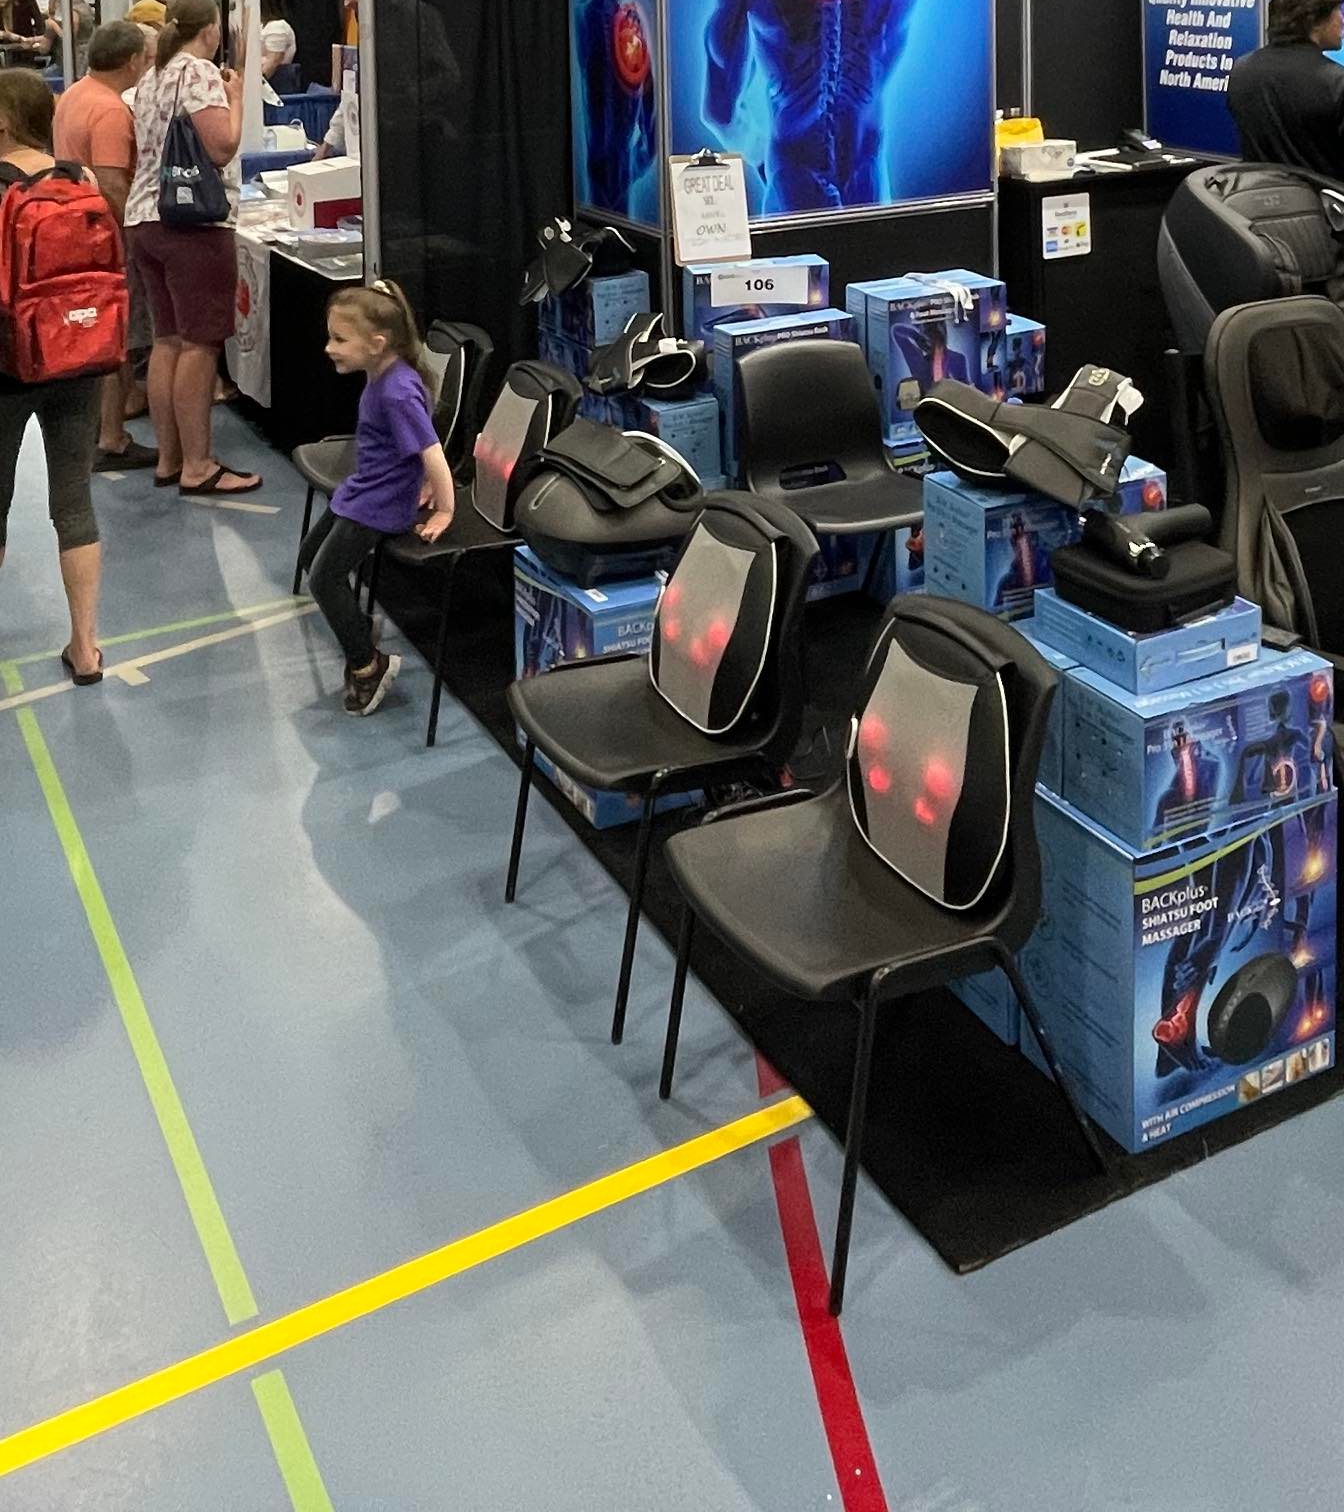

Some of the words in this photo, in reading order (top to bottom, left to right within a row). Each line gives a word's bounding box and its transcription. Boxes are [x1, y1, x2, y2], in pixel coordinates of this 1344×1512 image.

[1166, 9, 1205, 27] Health
[1206, 11, 1232, 29] And
[1168, 29, 1233, 50] Relaxation
[1165, 49, 1218, 70] Products
[1159, 69, 1191, 88] North
[1192, 73, 1230, 92] Ameri
[696, 223, 727, 236] OWN
[744, 278, 775, 291] 106
[617, 620, 654, 637] BACKp
[1141, 885, 1206, 914] BACKplus
[1142, 909, 1189, 930] SHIATSU
[1190, 896, 1219, 916] FOOT
[1141, 919, 1202, 946] MASSAGER
[1141, 1113, 1164, 1130] WITH
[1164, 1107, 1179, 1122] AIR
[1179, 1084, 1236, 1115] COMPRESSION
[1149, 1123, 1173, 1140] HEAT
